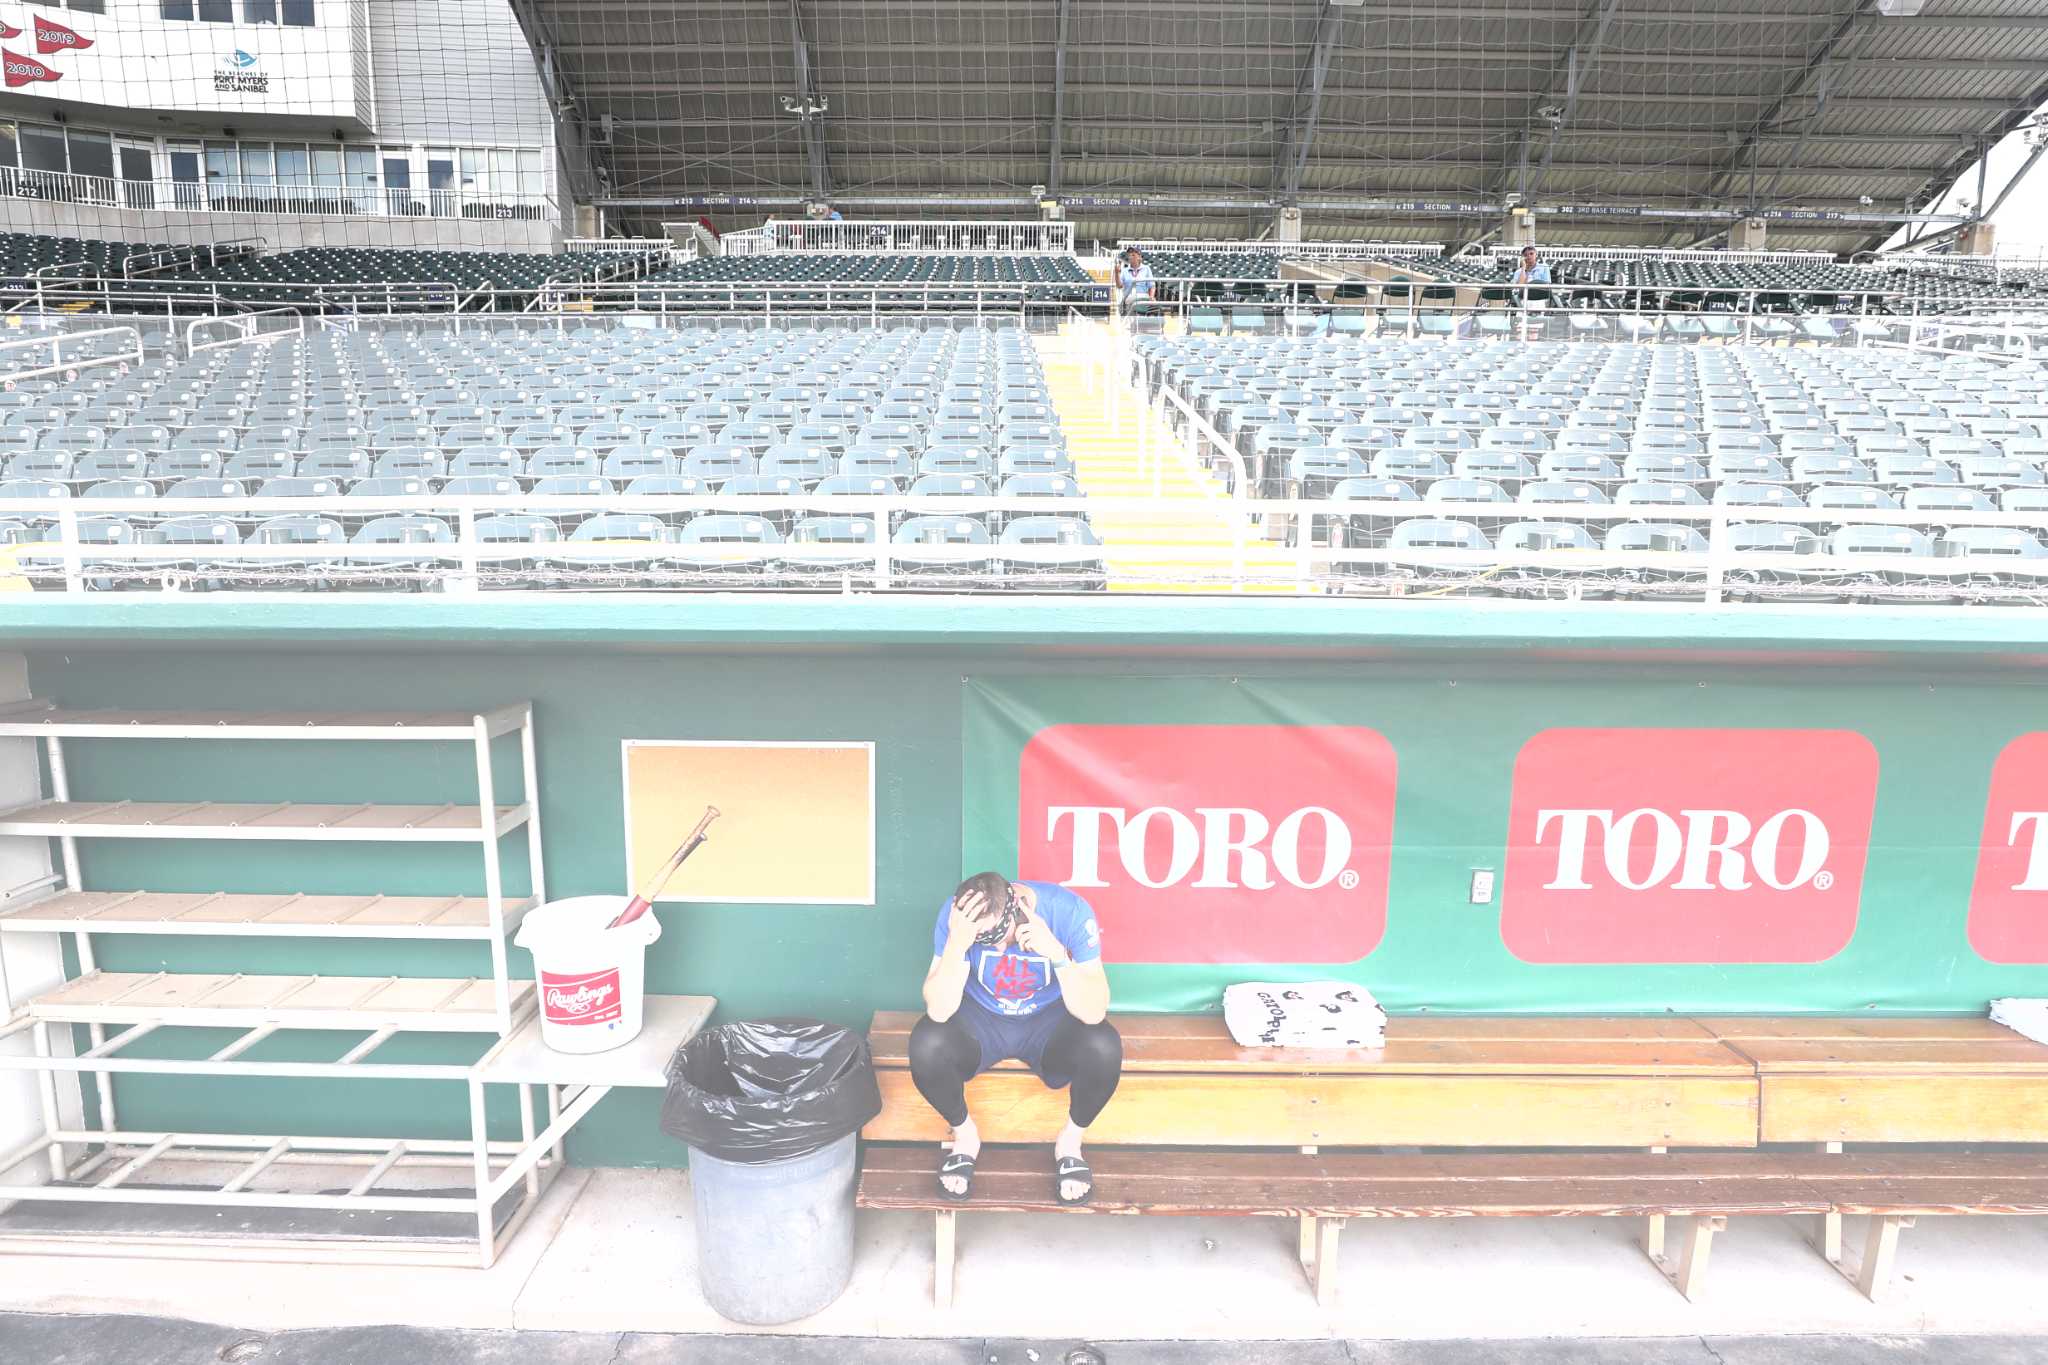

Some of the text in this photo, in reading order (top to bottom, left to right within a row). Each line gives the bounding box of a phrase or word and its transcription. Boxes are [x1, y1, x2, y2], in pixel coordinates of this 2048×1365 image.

[38, 28, 75, 45] 2019
[6, 61, 45, 78] 2010
[237, 76, 269, 86] MYERS
[231, 84, 269, 94] SANIBEL
[18, 186, 38, 197] 212
[702, 197, 730, 205] SECTION
[1093, 198, 1120, 206] SECTION
[1423, 203, 1451, 211] SECTION
[1591, 207, 1607, 215] BASE
[1608, 207, 1637, 215] TERRACE
[497, 208, 513, 218] 213
[1791, 210, 1818, 218] SECTION
[870, 226, 887, 235] 214
[1094, 290, 1108, 298] 214
[546, 983, 614, 1008] Rawlings
